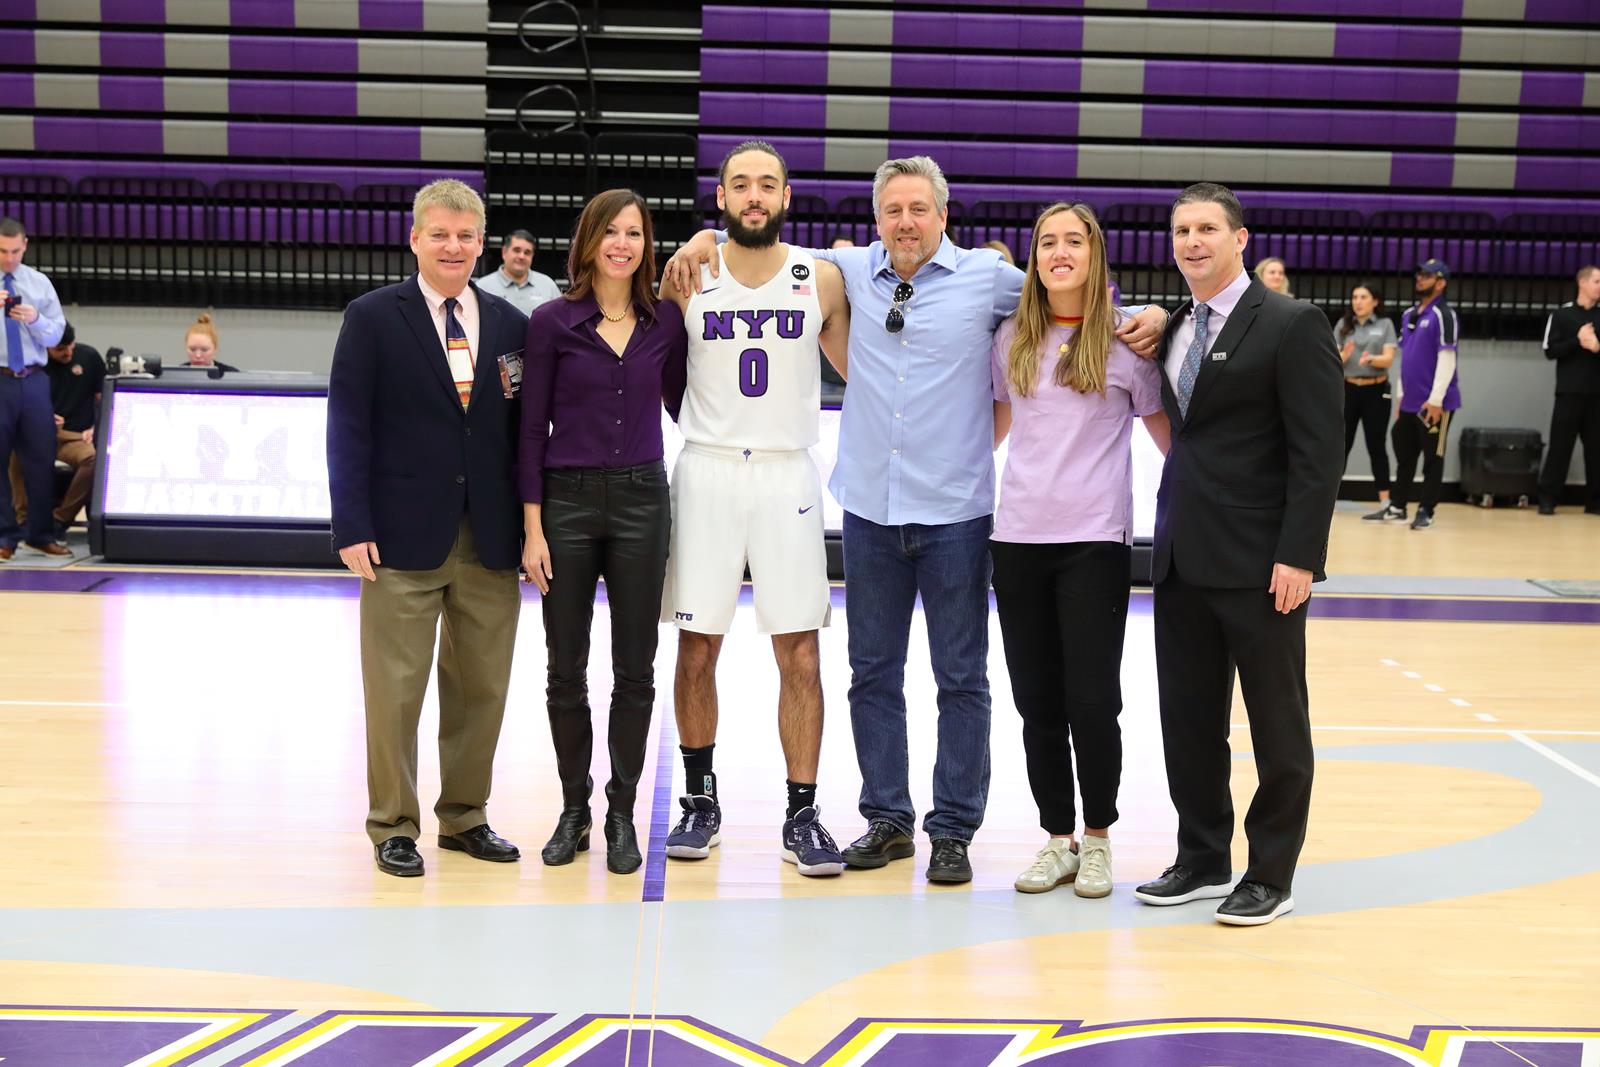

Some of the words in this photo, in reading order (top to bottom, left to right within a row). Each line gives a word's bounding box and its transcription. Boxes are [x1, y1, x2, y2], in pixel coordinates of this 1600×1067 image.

[793, 268, 808, 276] Cal
[702, 309, 805, 340] NYU
[738, 347, 769, 398] 0
[122, 482, 331, 517] BASKETBAL
